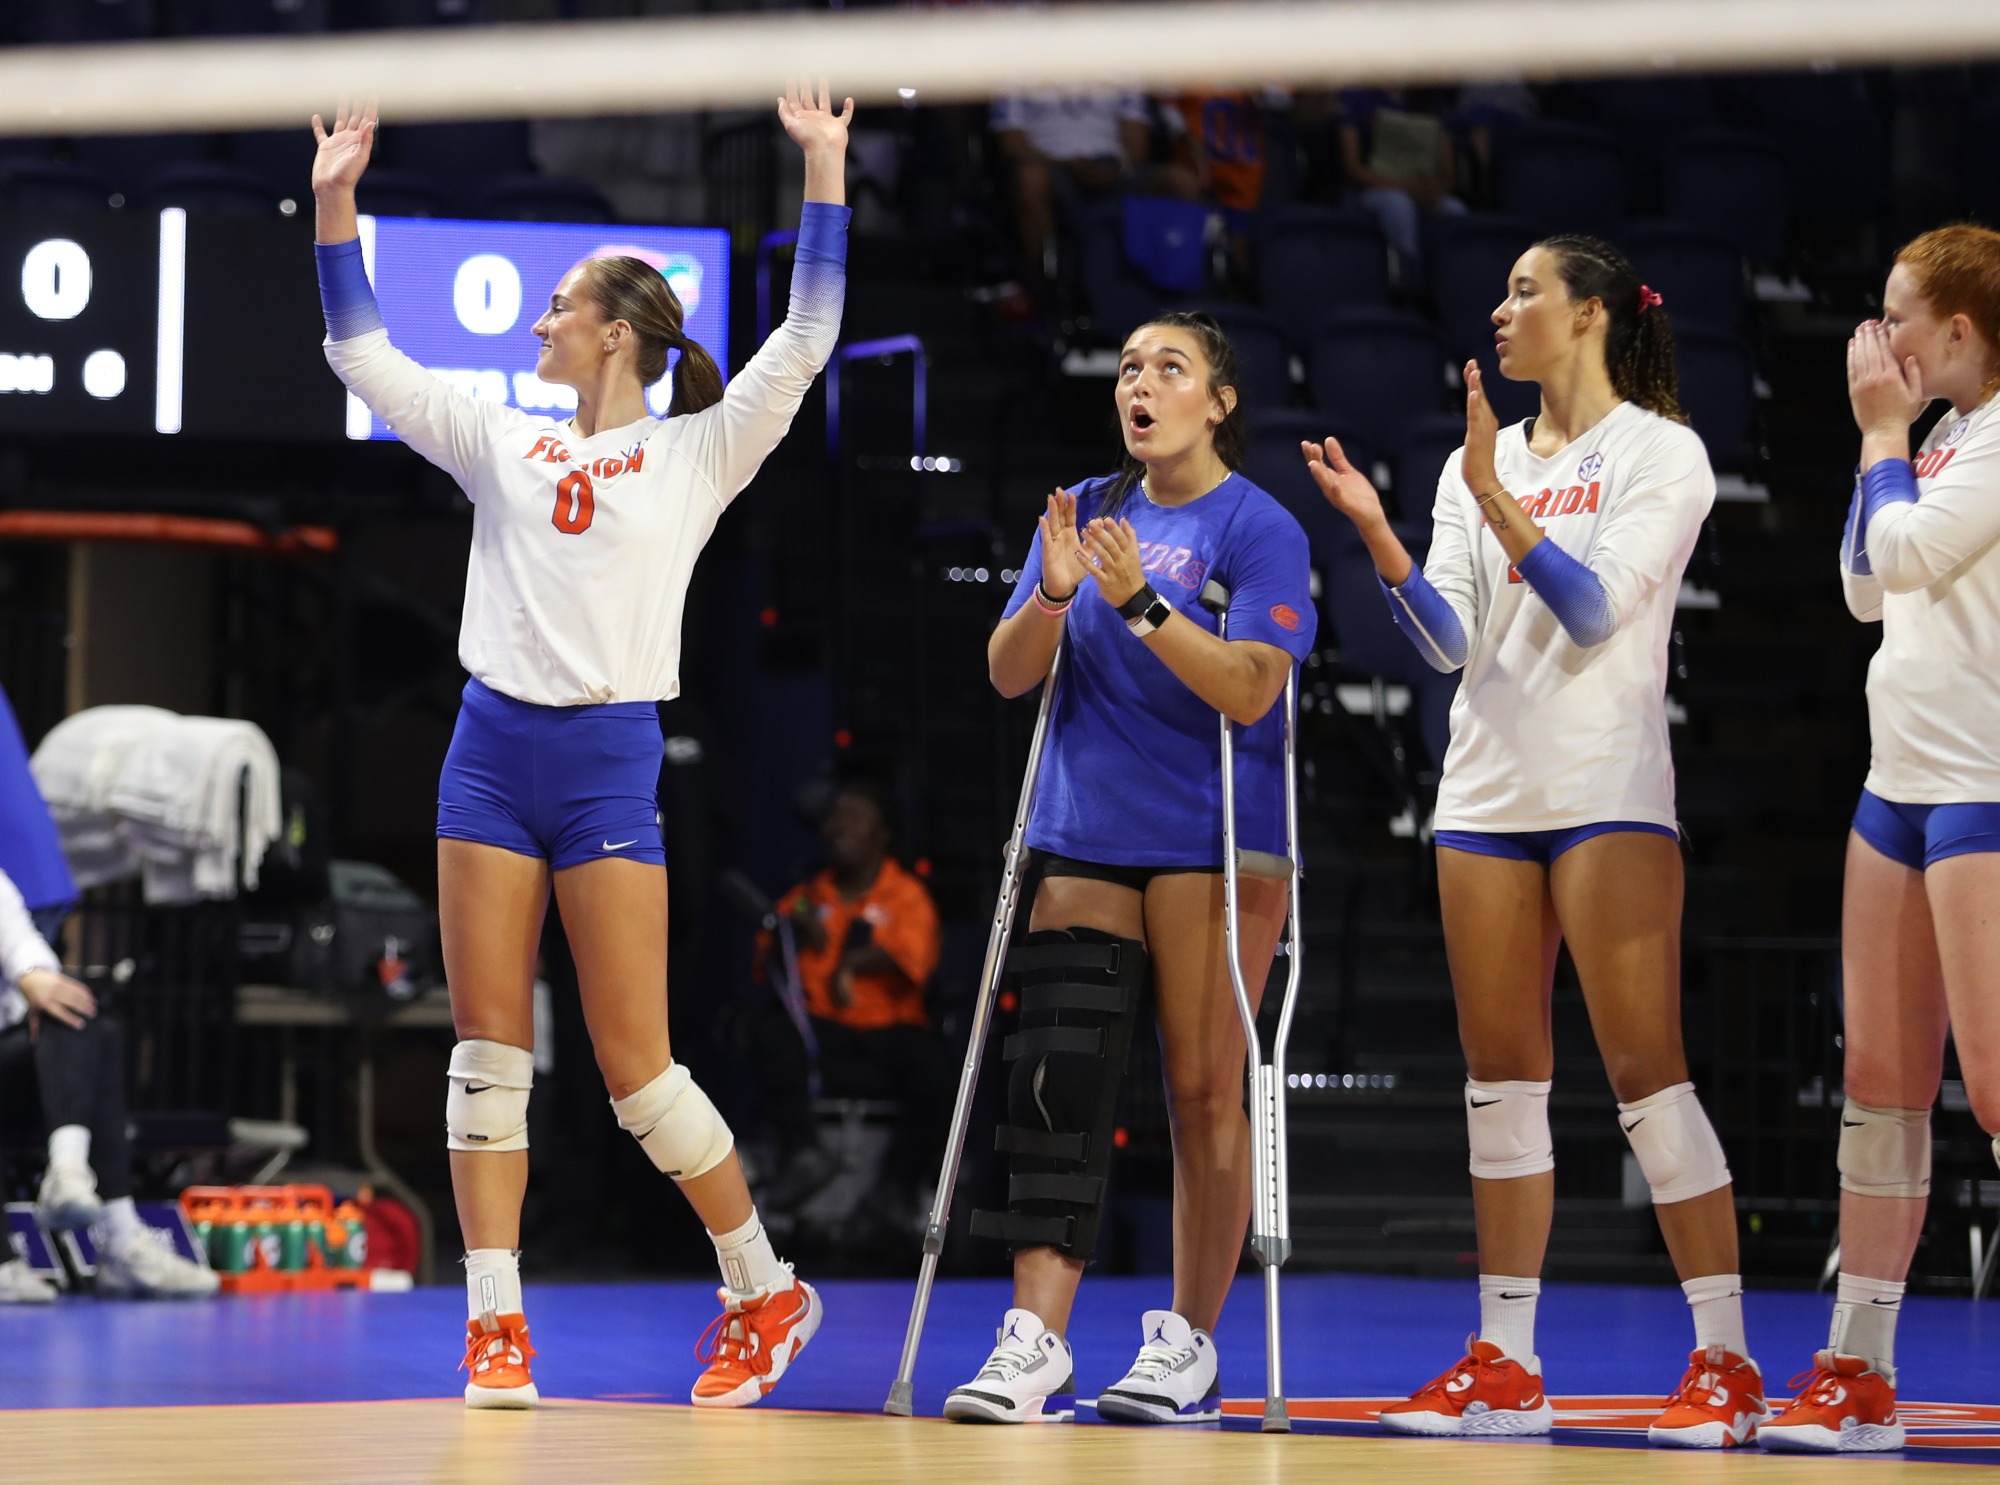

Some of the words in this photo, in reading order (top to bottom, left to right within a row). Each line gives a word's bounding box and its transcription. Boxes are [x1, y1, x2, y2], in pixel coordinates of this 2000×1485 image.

[22, 238, 92, 320] 0
[453, 254, 523, 335] 0
[551, 470, 595, 535] 0
